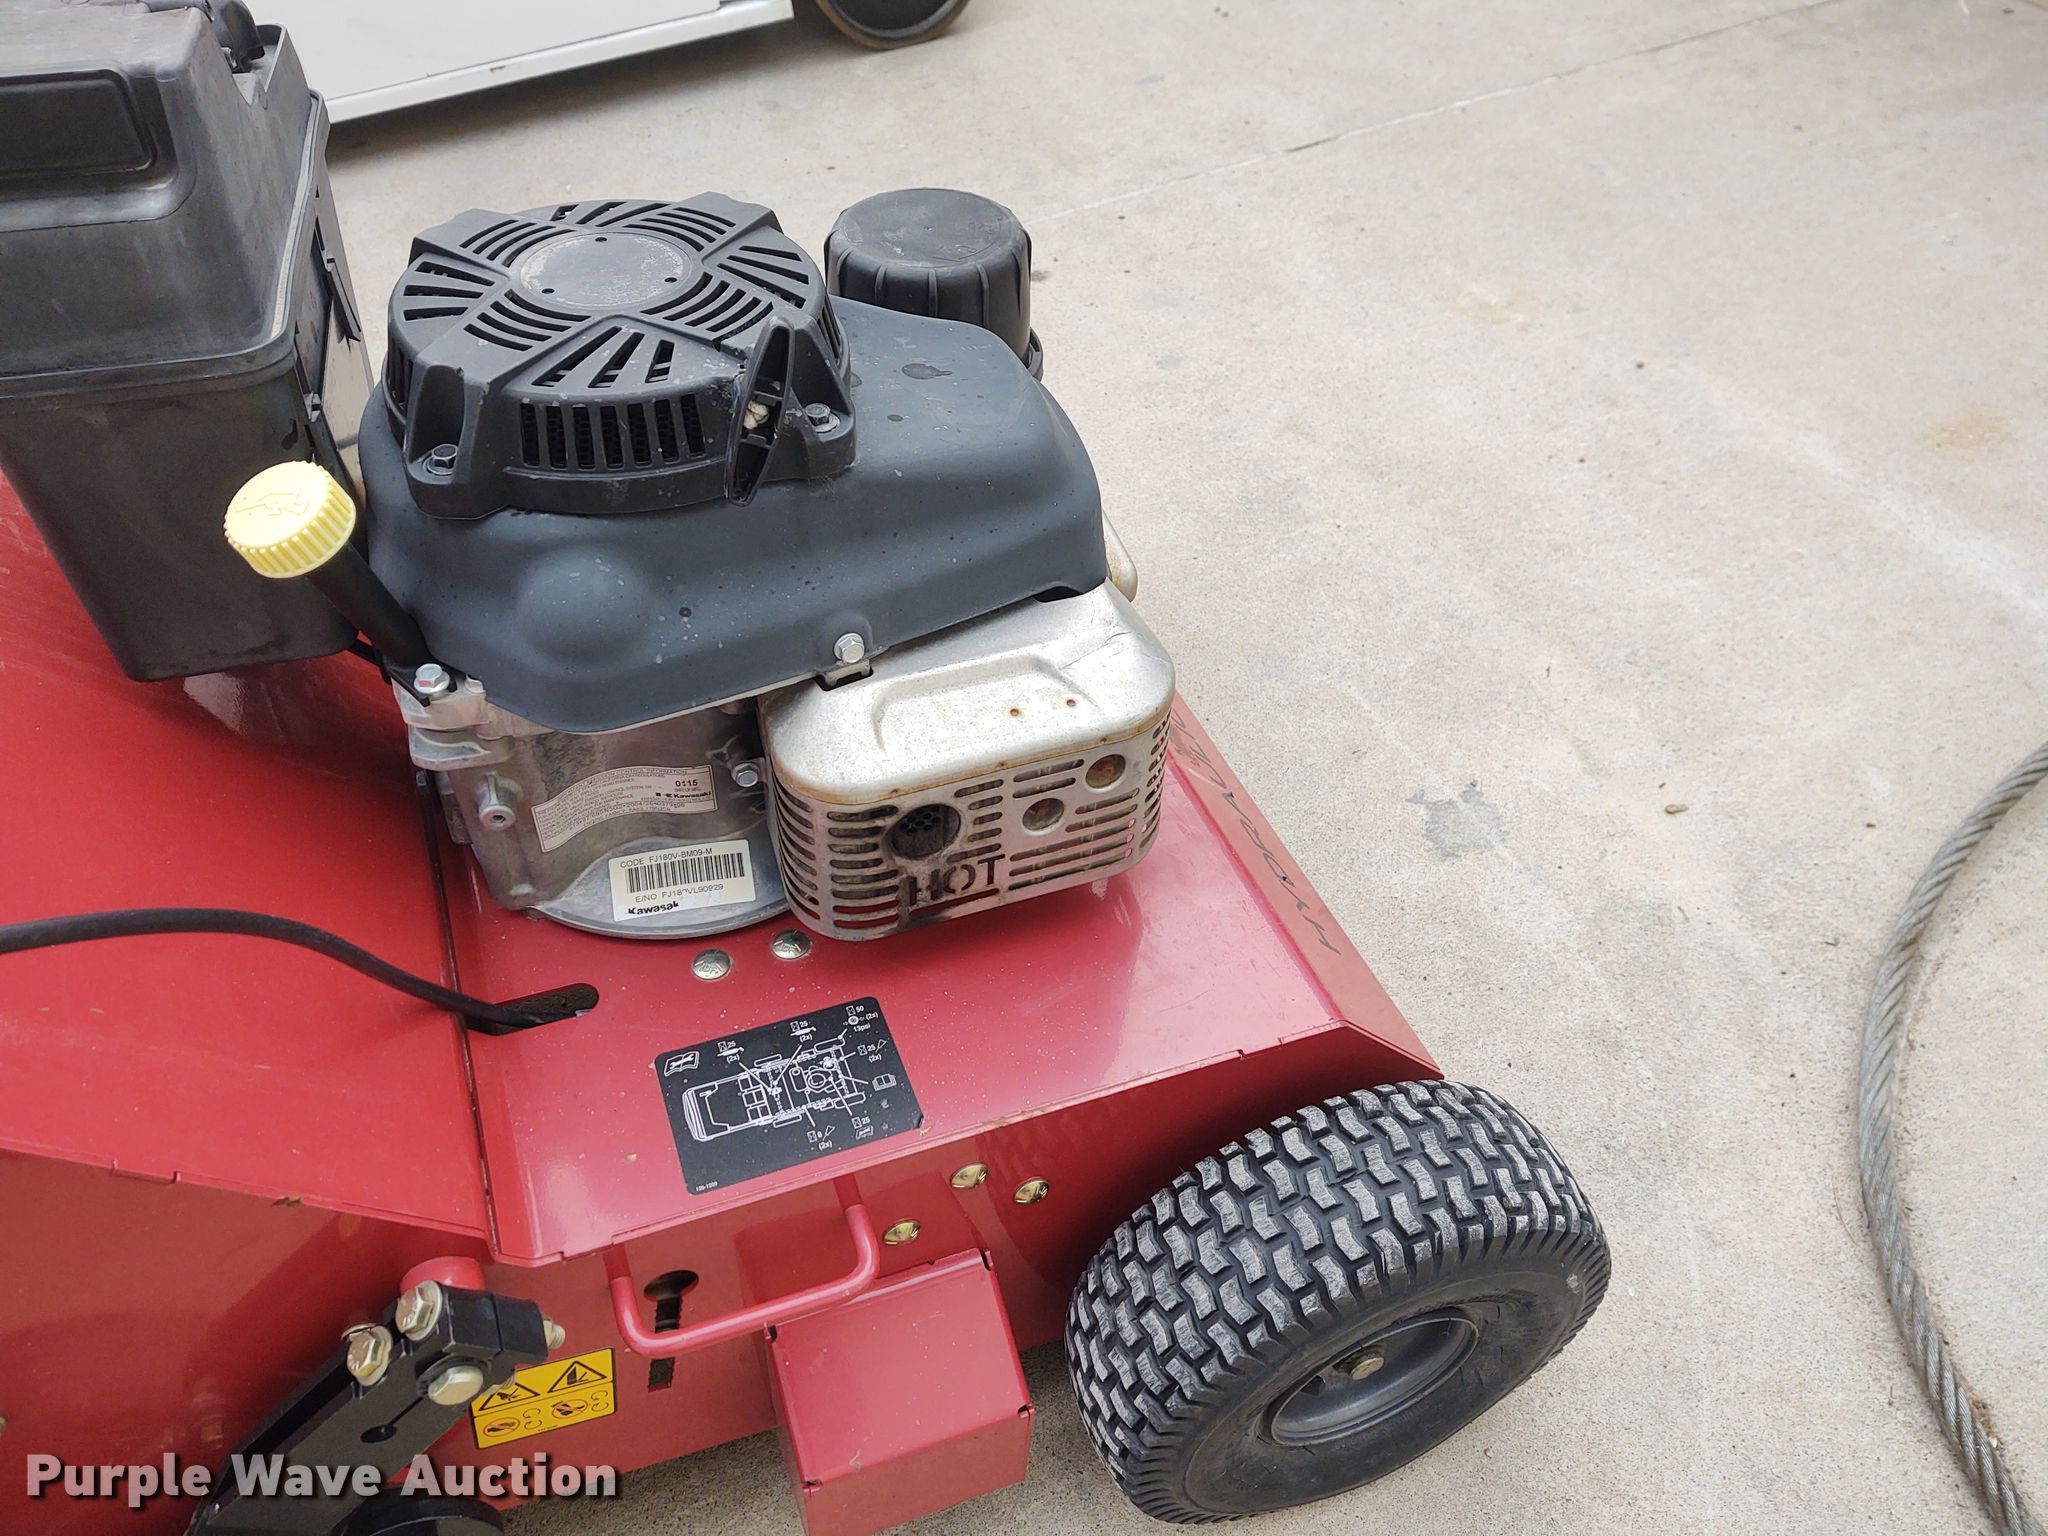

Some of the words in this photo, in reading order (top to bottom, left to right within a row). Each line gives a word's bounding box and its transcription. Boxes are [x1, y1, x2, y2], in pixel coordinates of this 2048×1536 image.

[620, 857, 645, 869] CODE
[908, 854, 1005, 905] HOT
[635, 893, 658, 903] E/NO
[853, 1022, 871, 1032] 13psi
[800, 1034, 813, 1043] (2x)
[727, 1040, 736, 1048] 25
[867, 1044, 876, 1052] 25
[727, 1054, 740, 1064] (2x)
[868, 1053, 882, 1063] (2x)
[861, 1116, 871, 1125] 25
[819, 1140, 833, 1151] (2x)
